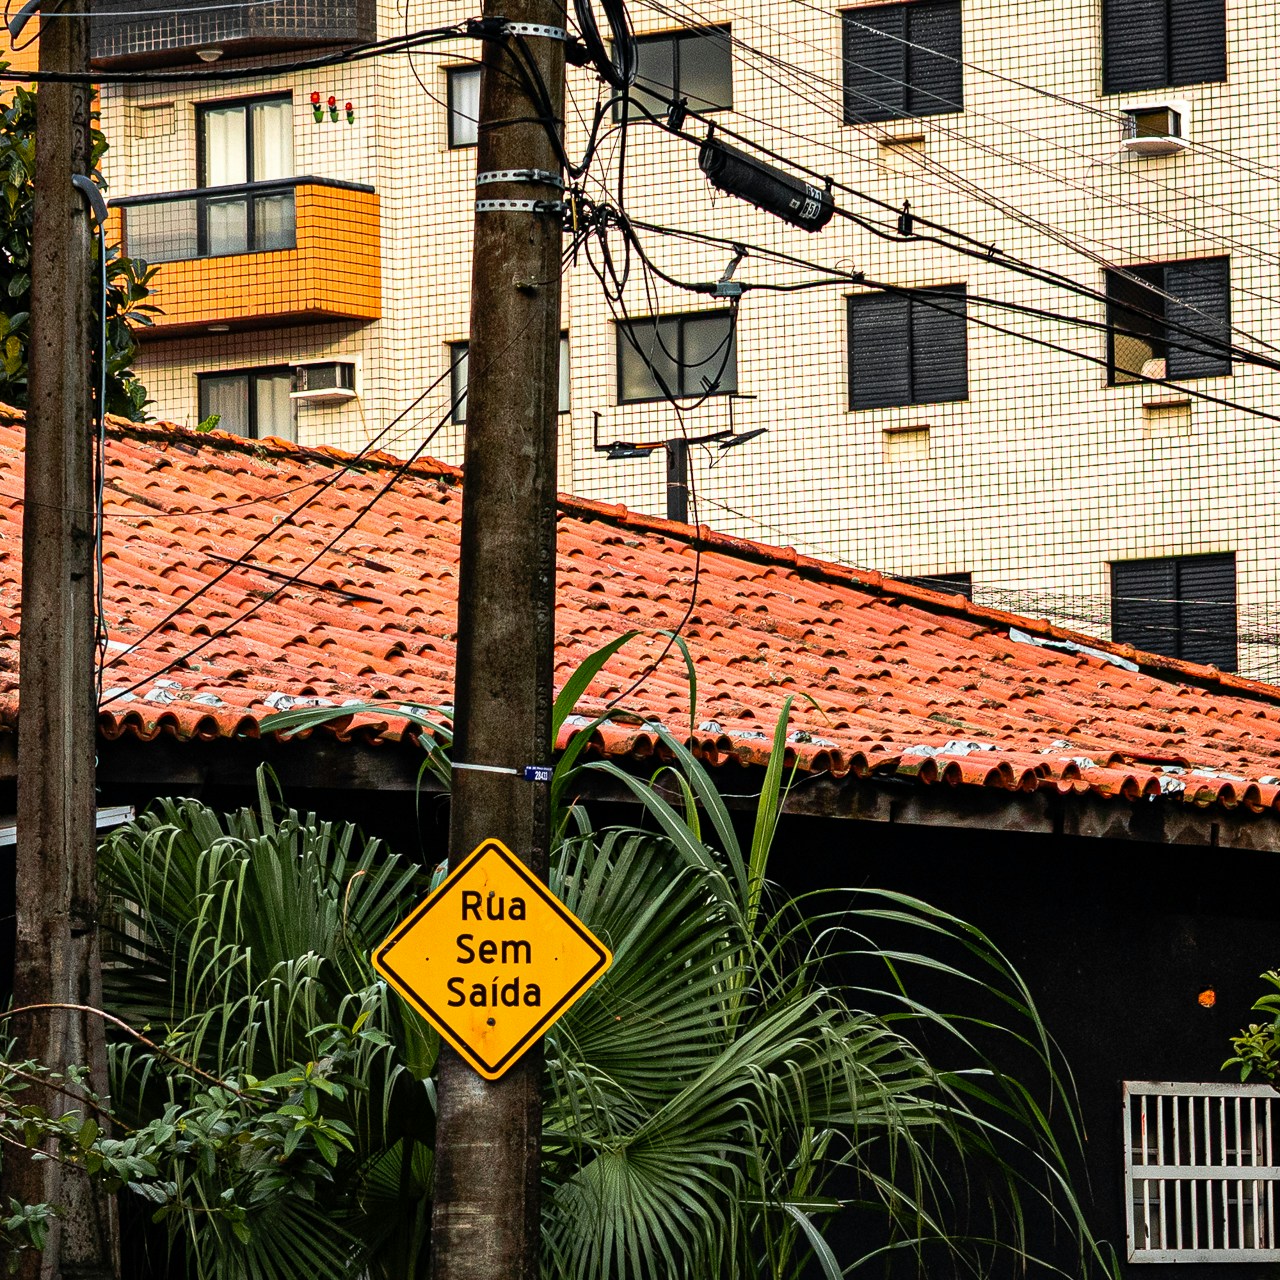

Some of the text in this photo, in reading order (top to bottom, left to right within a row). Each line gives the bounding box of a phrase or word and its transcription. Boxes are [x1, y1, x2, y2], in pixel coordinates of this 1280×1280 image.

[461, 890, 527, 921] Rua
[456, 933, 532, 965] Sem
[446, 975, 541, 1008] Saída
